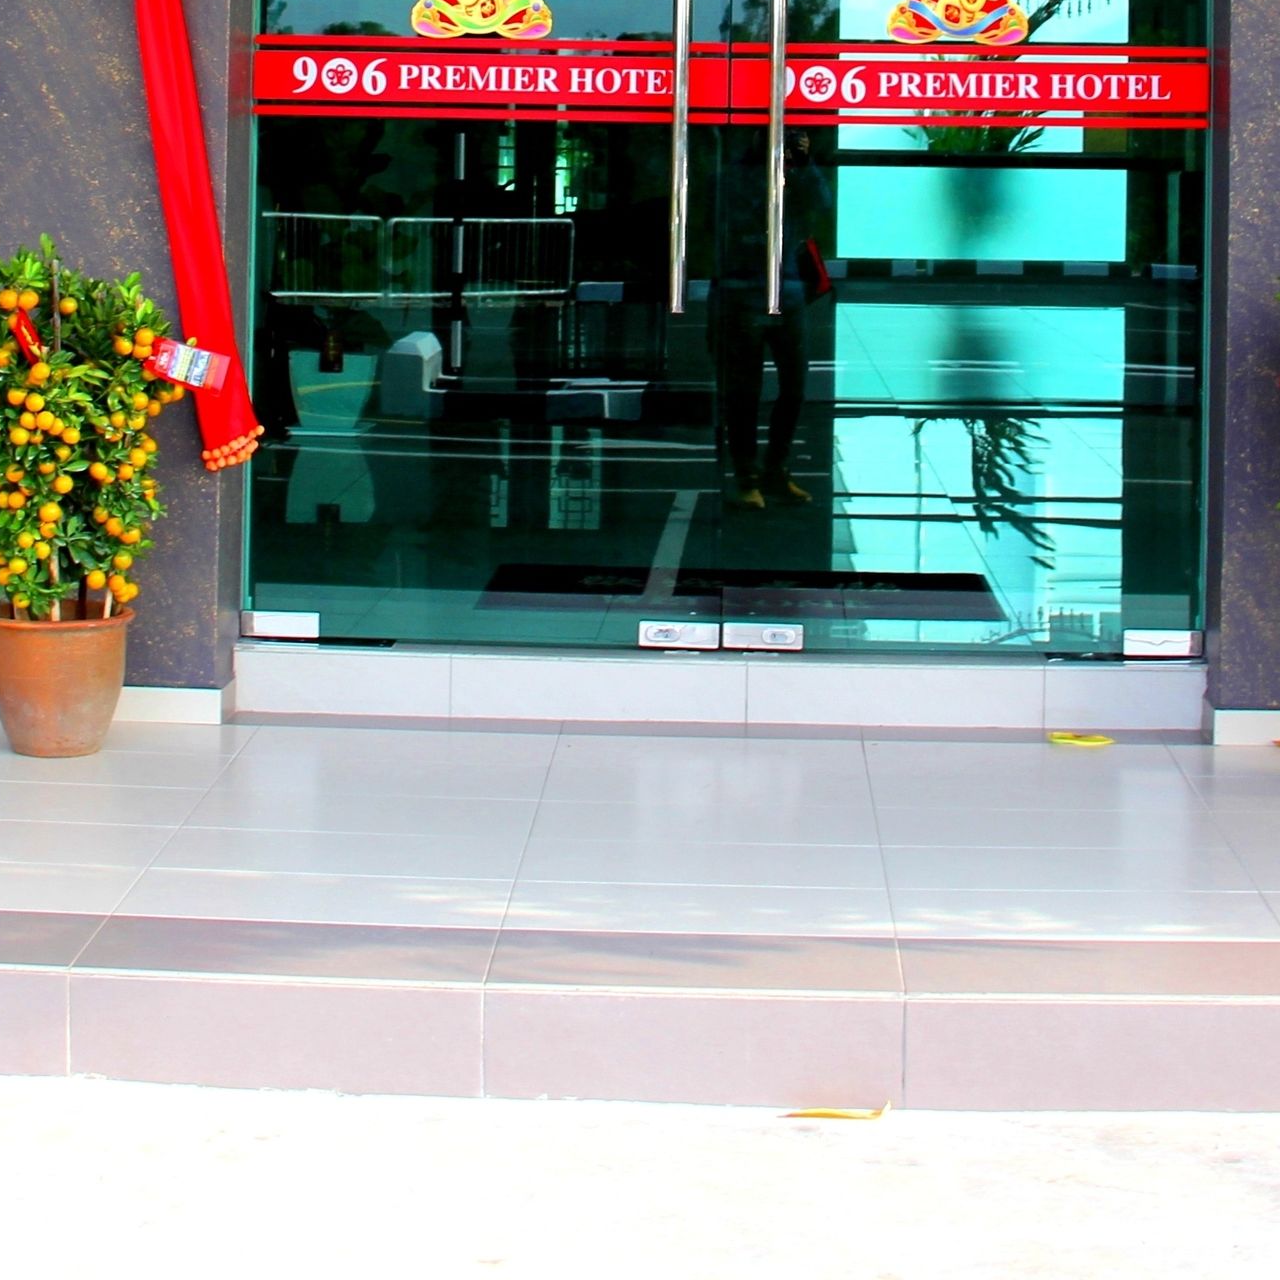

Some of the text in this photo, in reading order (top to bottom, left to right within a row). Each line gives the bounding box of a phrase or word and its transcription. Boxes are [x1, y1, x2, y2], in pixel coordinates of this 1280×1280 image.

[398, 64, 560, 93] PREMIER
[569, 67, 674, 95] HOTE
[878, 72, 1040, 99] PREMIER
[1050, 74, 1171, 100] HOTEL
